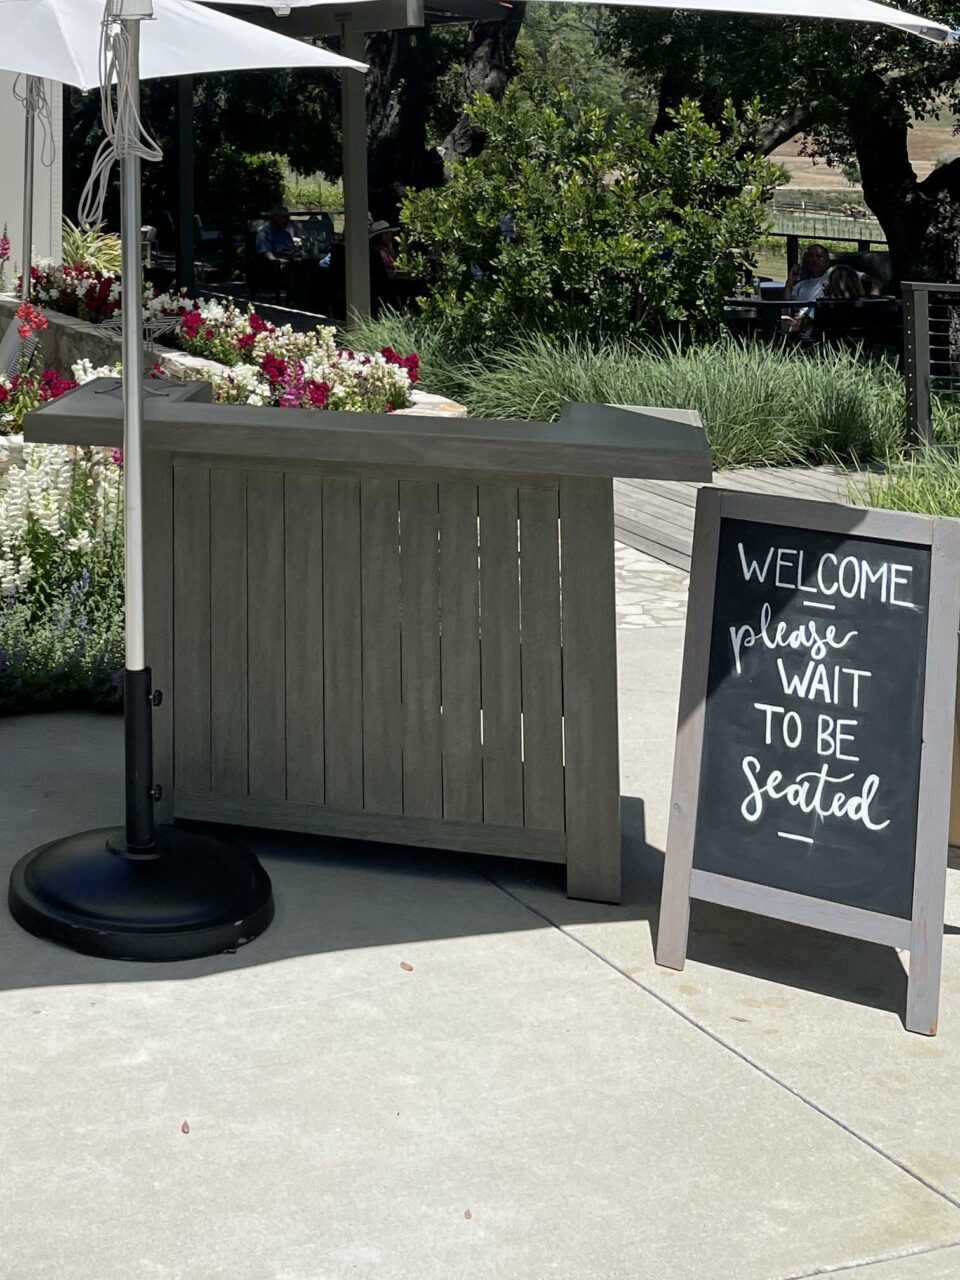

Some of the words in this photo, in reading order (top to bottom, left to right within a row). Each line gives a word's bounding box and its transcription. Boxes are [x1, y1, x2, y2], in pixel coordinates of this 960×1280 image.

[737, 542, 914, 608] WELCOME
[729, 603, 859, 675] please
[776, 657, 872, 708] WAIT
[754, 703, 803, 748] TO
[816, 714, 860, 762] BE
[740, 755, 891, 831] Seated
